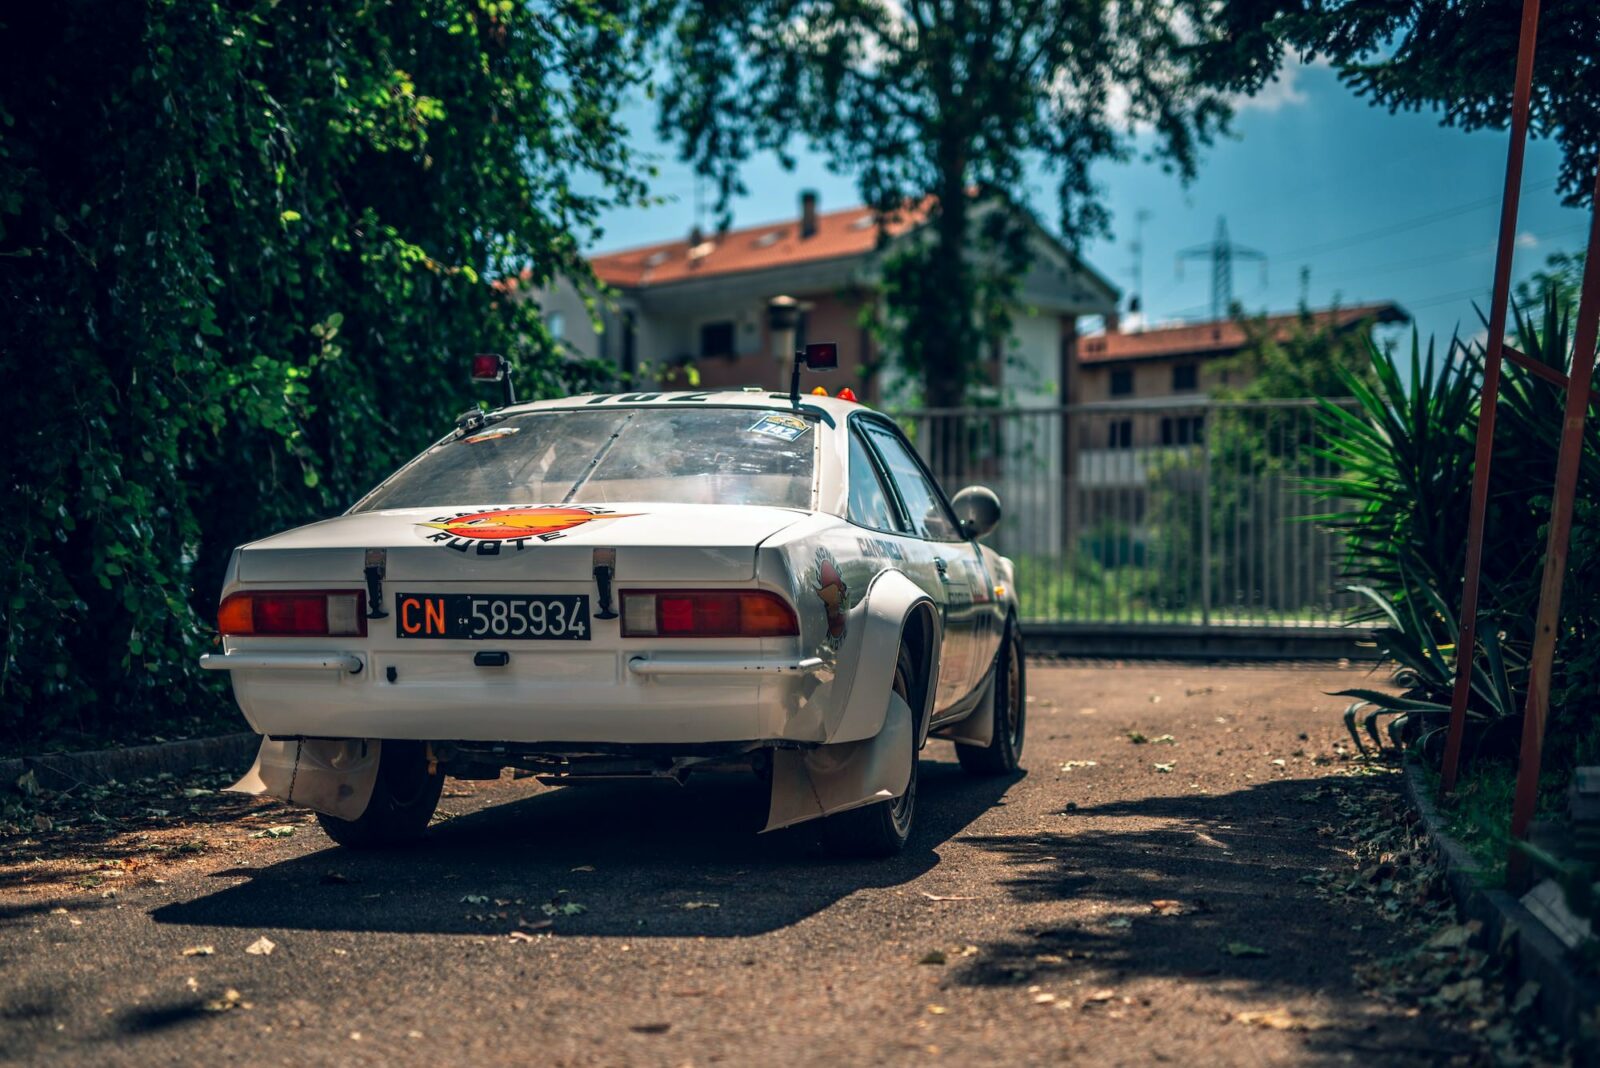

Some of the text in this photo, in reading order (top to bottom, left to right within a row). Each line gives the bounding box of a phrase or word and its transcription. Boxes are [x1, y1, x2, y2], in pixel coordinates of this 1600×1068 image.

[426, 531, 568, 555] RUOTE
[401, 598, 446, 634] CN
[472, 599, 586, 636] 585934
